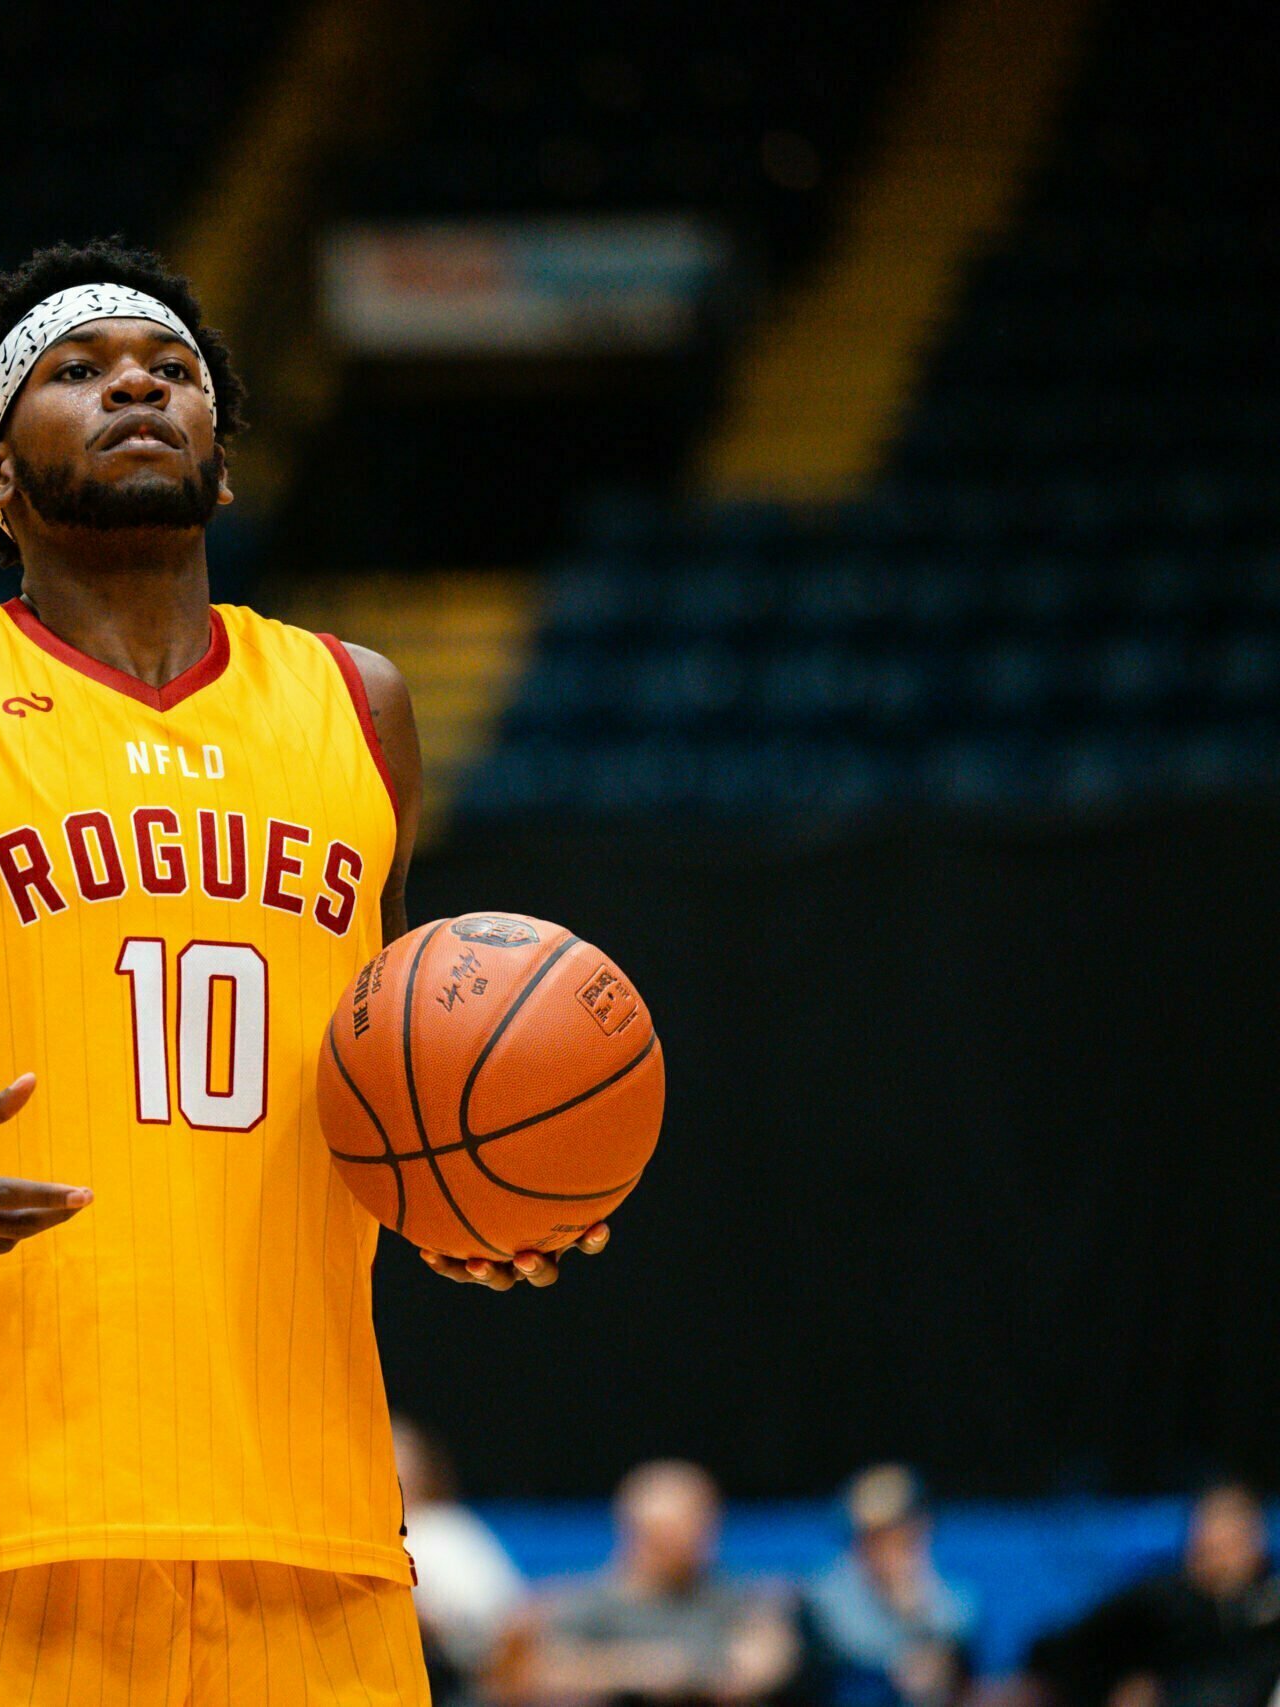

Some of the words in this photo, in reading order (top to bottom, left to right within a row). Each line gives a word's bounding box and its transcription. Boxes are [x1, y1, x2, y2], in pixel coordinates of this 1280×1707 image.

[127, 742, 225, 779] NFLD
[471, 978, 488, 995] CEO
[115, 937, 268, 1133] 10
[353, 1001, 370, 1039] THE
